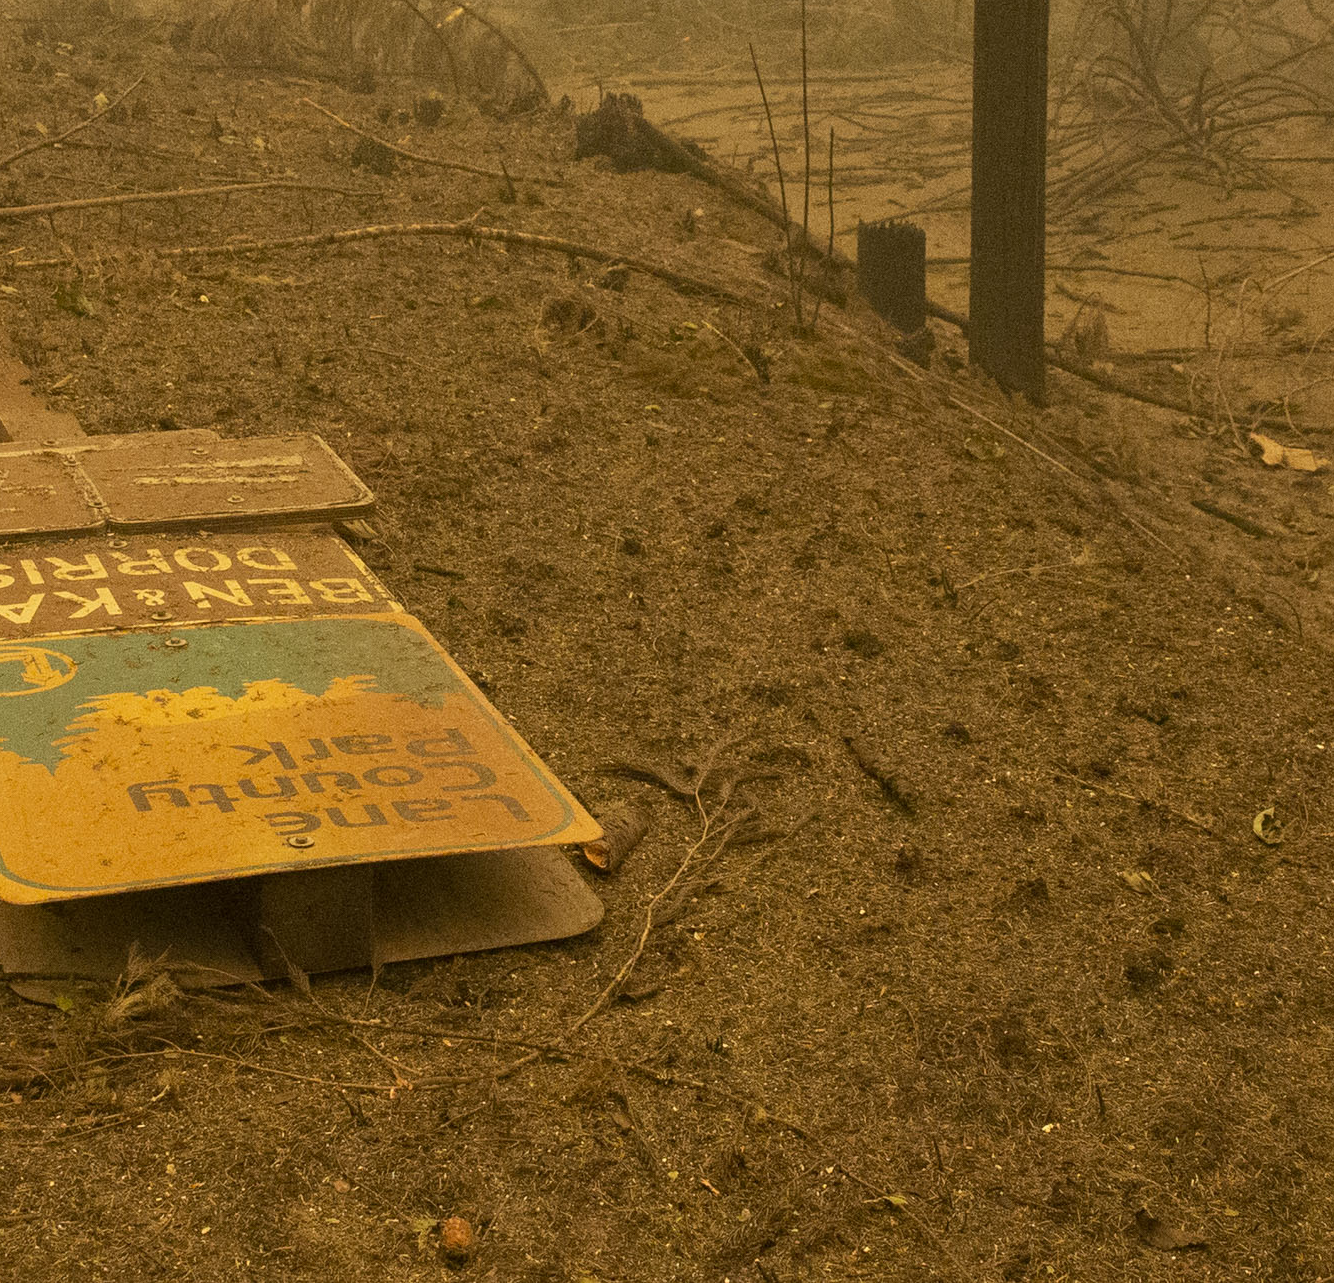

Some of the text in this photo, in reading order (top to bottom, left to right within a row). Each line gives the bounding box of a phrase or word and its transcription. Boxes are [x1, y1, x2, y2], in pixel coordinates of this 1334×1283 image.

[137, 587, 169, 607] &
[183, 578, 375, 609] BEN
[231, 727, 478, 770] Park
[128, 760, 498, 813] County
[267, 793, 531, 836] Lane
